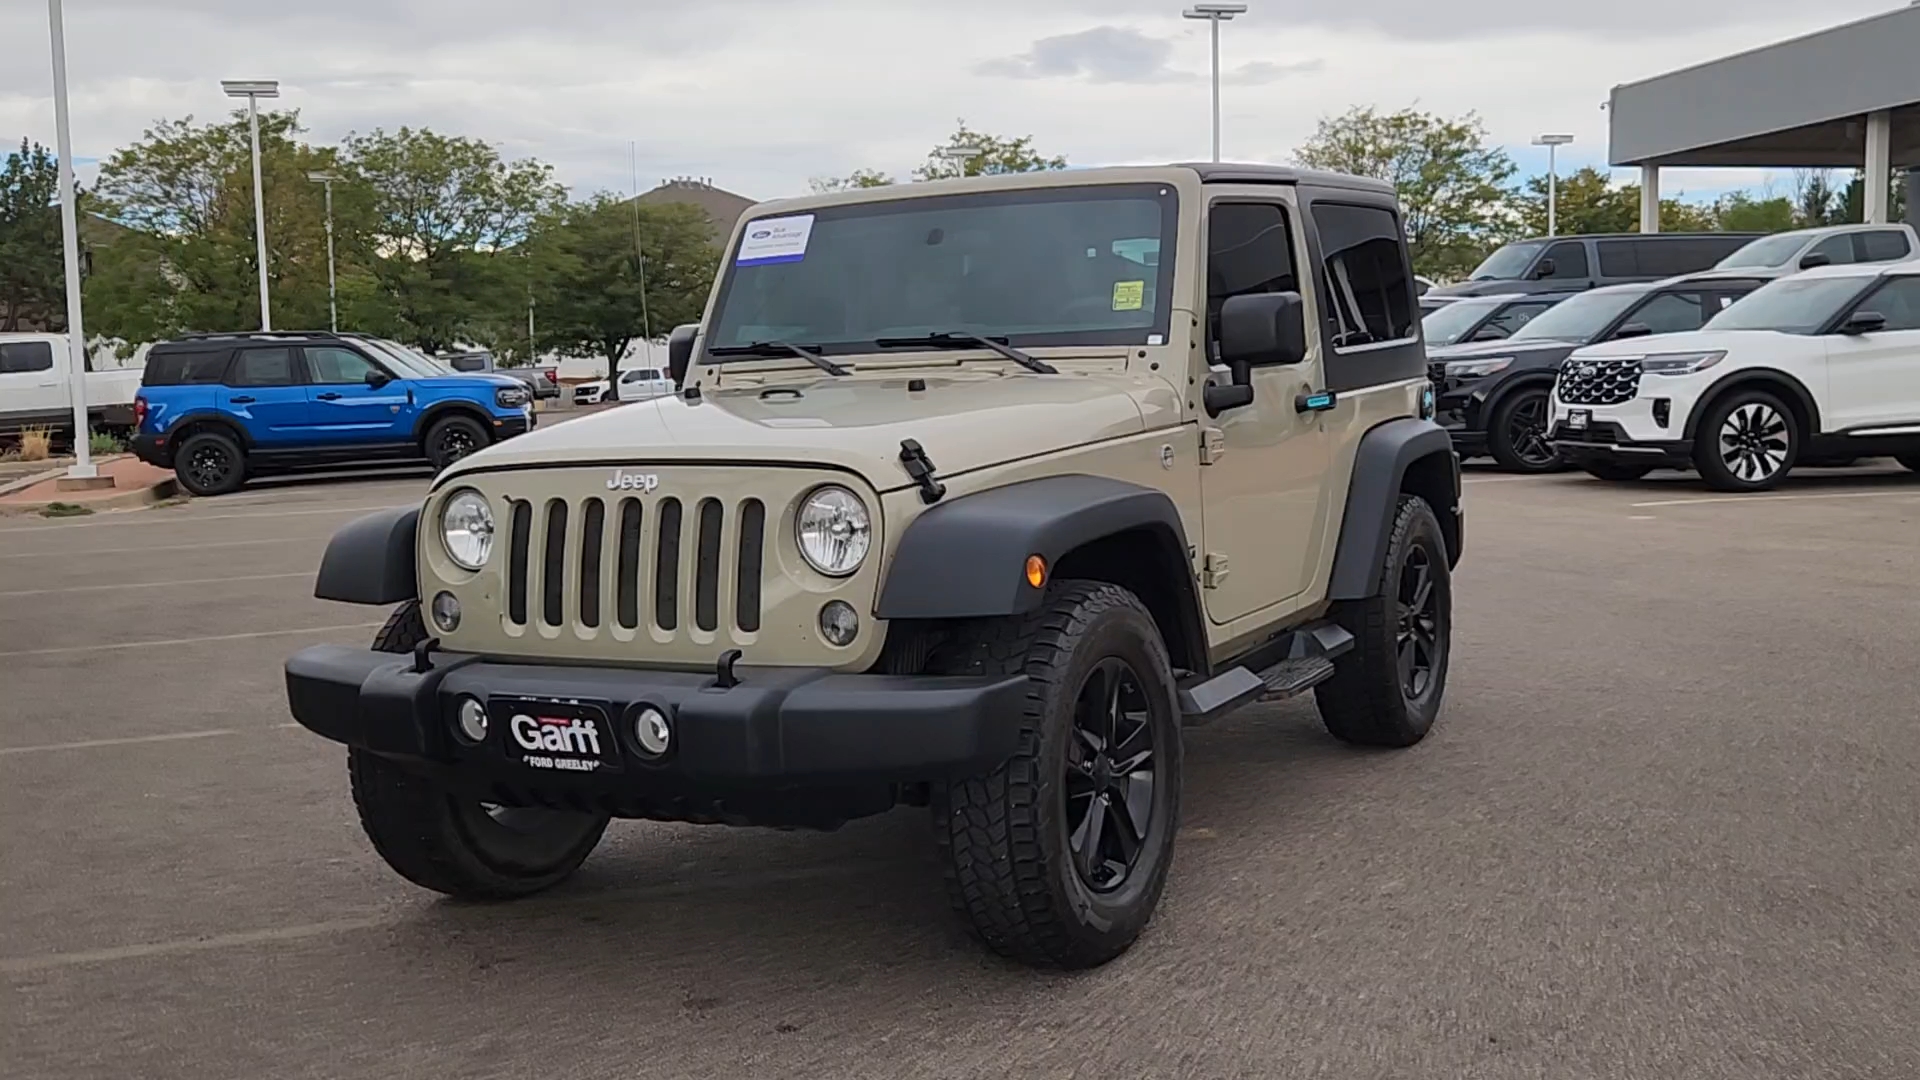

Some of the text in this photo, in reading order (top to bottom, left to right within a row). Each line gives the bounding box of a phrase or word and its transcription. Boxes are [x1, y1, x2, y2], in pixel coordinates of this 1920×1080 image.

[607, 469, 659, 495] Jeep
[511, 714, 601, 755] Garff
[529, 756, 554, 768] FORD
